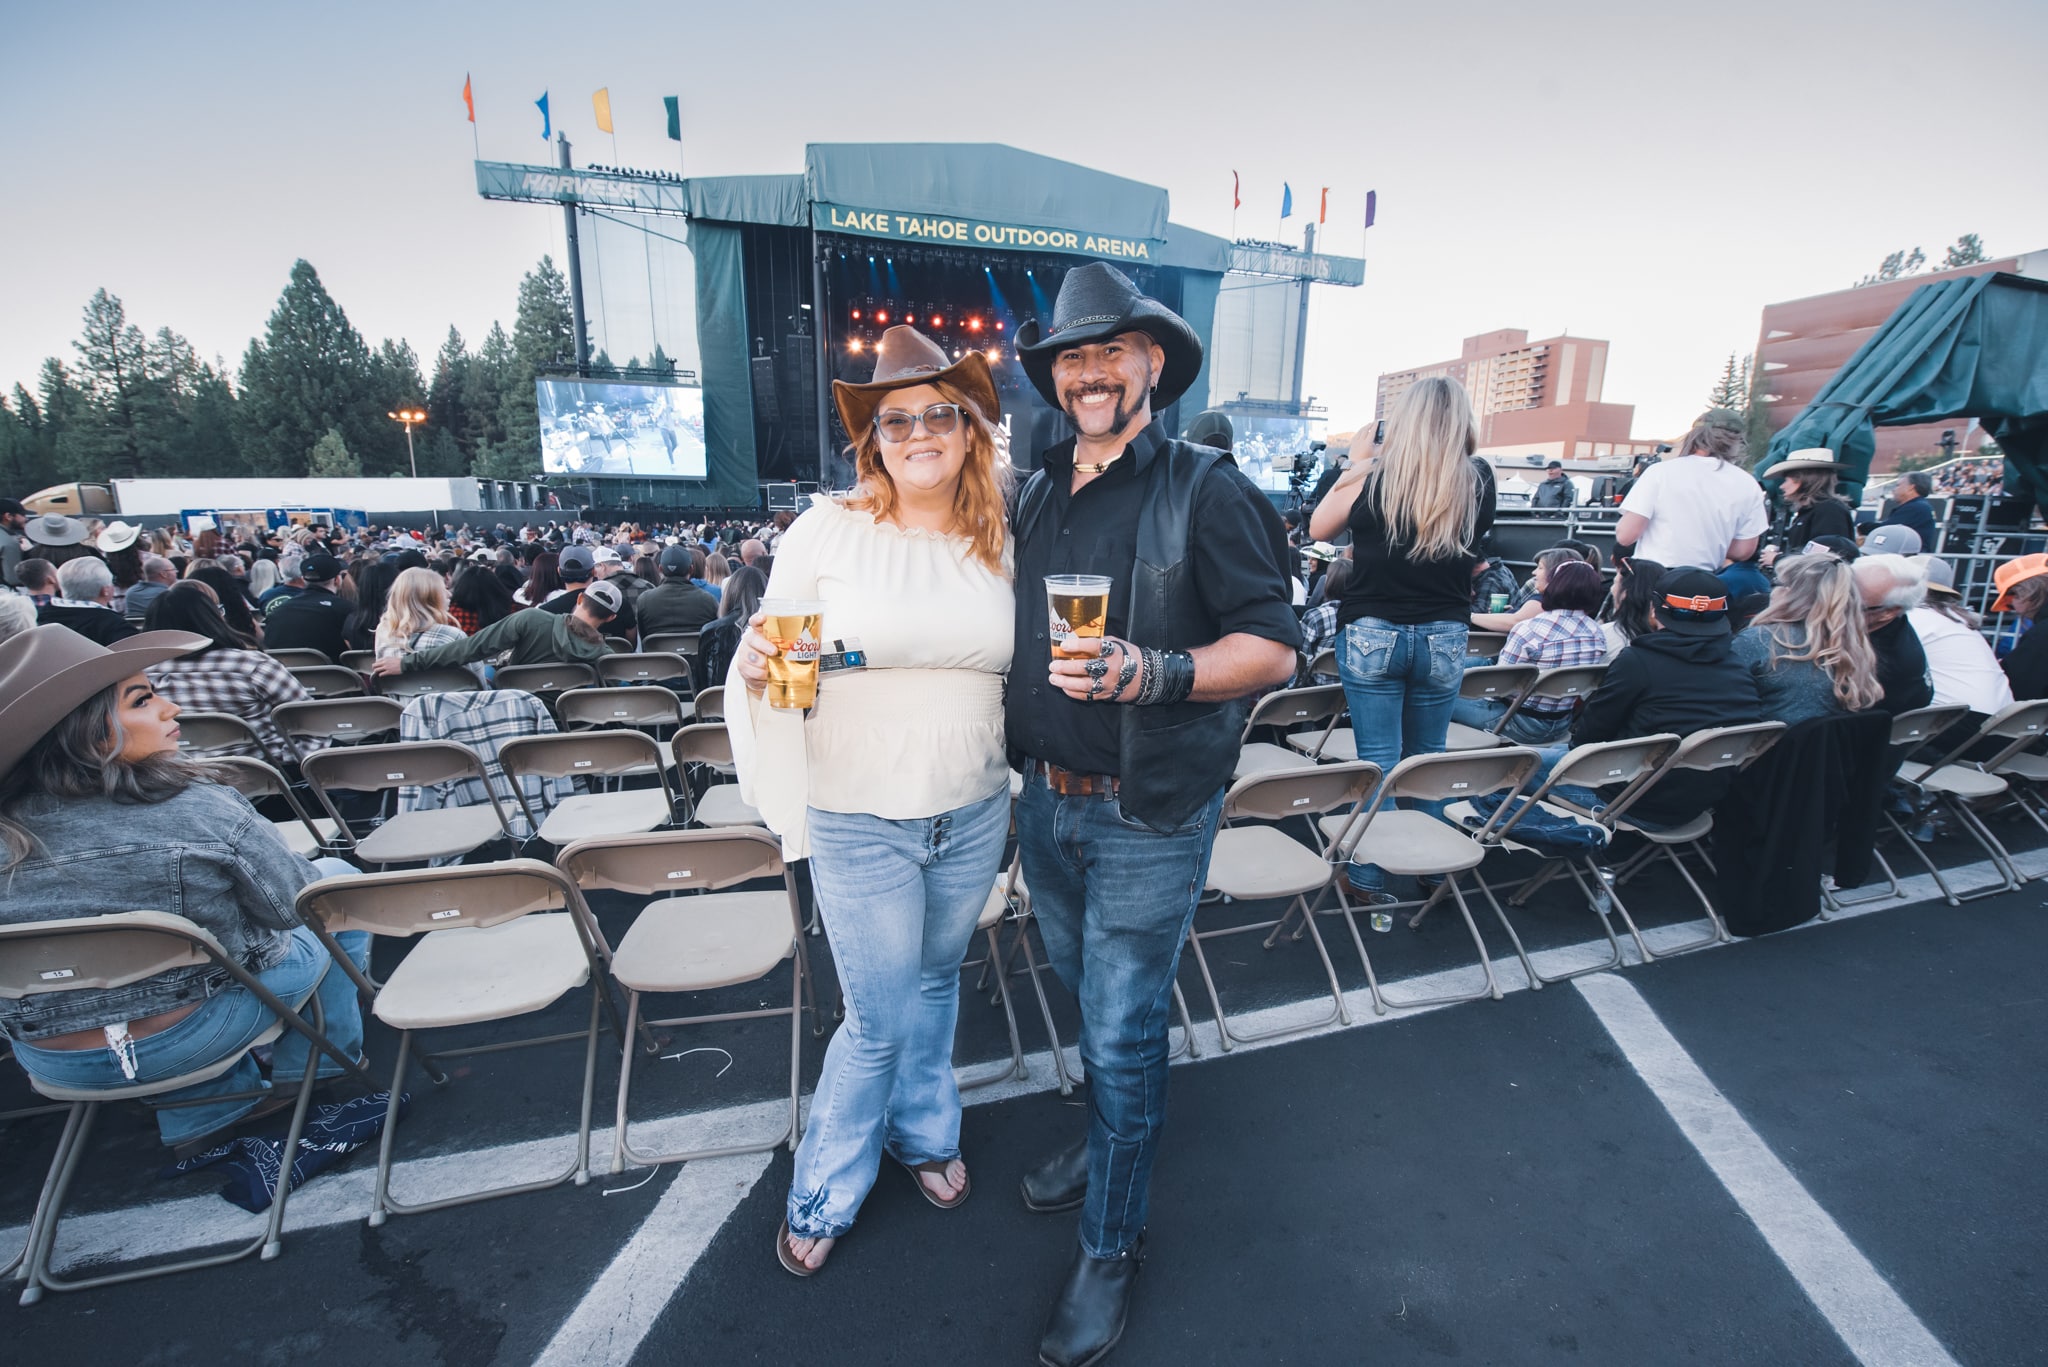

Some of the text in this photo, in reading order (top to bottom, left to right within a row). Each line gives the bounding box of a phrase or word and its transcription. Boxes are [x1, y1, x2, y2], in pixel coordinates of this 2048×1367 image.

[522, 172, 640, 199] HARVEYS
[831, 208, 1149, 259] LAKE TAHOE OUTDOOR ARENA
[797, 651, 817, 659] LIGHT
